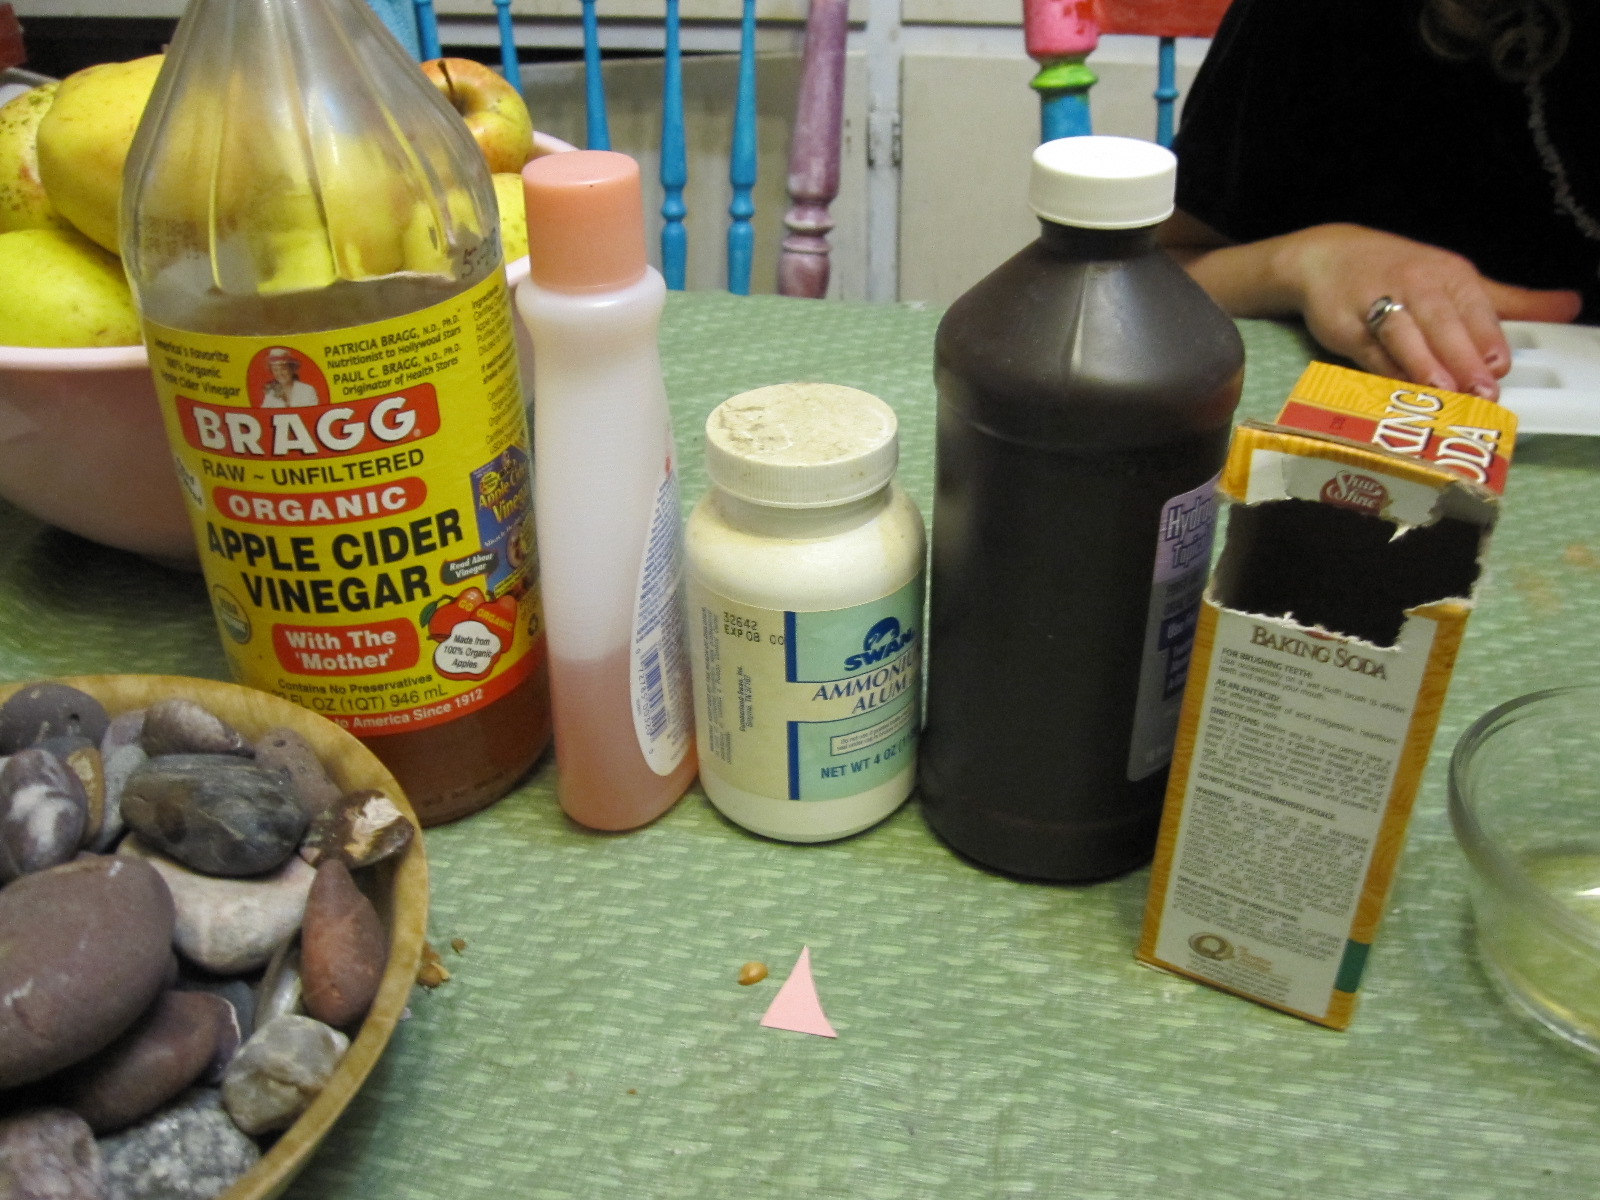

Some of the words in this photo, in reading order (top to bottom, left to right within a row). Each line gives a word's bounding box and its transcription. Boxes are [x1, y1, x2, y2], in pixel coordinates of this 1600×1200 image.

[324, 338, 378, 357] PATRICIA
[381, 328, 419, 348] BRAGG,
[327, 352, 383, 370] Nutritionist
[385, 348, 395, 358] to
[398, 335, 441, 354] Hollywood
[443, 326, 461, 341] Stars
[333, 370, 364, 385] PAUL
[367, 367, 378, 379] C.
[382, 356, 421, 376] BRAGG,
[342, 378, 392, 396] Originator
[394, 373, 404, 386] of
[406, 365, 434, 382] Health
[435, 357, 459, 372] Stores
[201, 382, 241, 400] Vinegar
[192, 396, 417, 456] BRAGG
[1371, 389, 1443, 459] KING
[202, 458, 245, 483] RAW
[272, 448, 425, 487] UNFILTERED
[228, 486, 407, 522] ORGANIC
[206, 521, 320, 573] APPLE
[331, 508, 463, 571] CIDER
[449, 558, 470, 572] Read
[472, 553, 494, 566] About
[455, 563, 487, 579] Vinegar
[241, 565, 432, 614] VINEGAR
[459, 600, 474, 612] GO
[476, 608, 514, 632] ORGANIC
[723, 611, 757, 631] 32642
[724, 624, 743, 638] EXP
[284, 630, 341, 650] With
[346, 630, 397, 649] The
[444, 646, 463, 655] 100%
[465, 648, 492, 659] Organic
[453, 635, 473, 645] Made
[474, 637, 490, 646] from
[1250, 624, 1330, 664] BAKING
[1333, 647, 1388, 681] SODA
[294, 648, 394, 671] 'Mother'
[452, 659, 478, 669] Apples
[278, 678, 326, 694] Contains
[329, 684, 346, 695] No
[349, 674, 433, 693] Preservatives
[312, 697, 337, 711] OZ
[340, 697, 385, 712] (1QT)
[390, 690, 419, 708] 946
[424, 684, 448, 700] mL
[852, 673, 907, 715] ALUM
[353, 713, 410, 728] America
[412, 702, 452, 721] Since
[455, 688, 484, 708] 1912
[821, 761, 847, 780] NET
[851, 757, 870, 775] WT
[874, 753, 880, 765] 4
[884, 744, 897, 761] OZ
